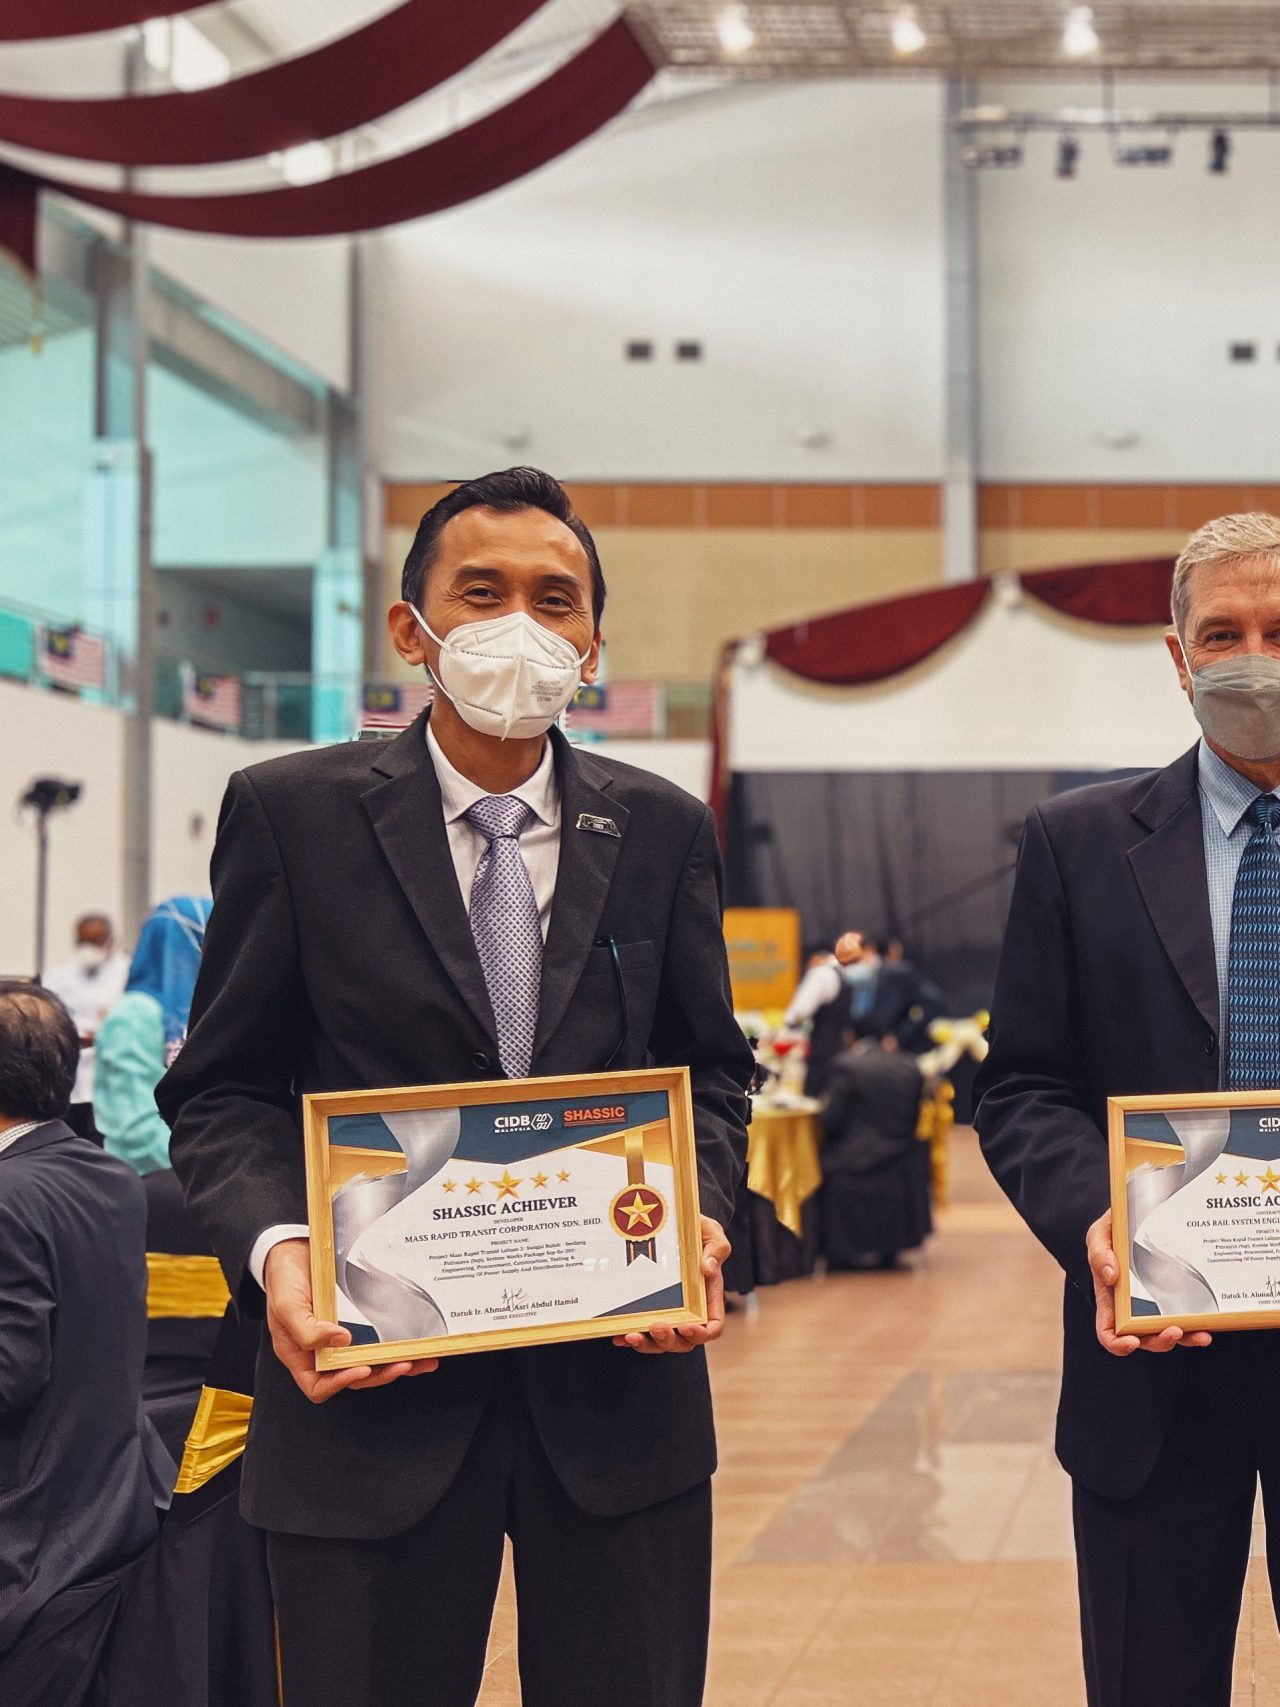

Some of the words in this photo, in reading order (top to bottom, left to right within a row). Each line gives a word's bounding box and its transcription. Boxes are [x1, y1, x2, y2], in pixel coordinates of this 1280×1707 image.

[494, 1115, 530, 1128] CIDB
[564, 1106, 625, 1122] SHASSIC
[432, 1203, 497, 1221] SHASSIC
[501, 1196, 578, 1215] ACHIEVER
[1206, 1196, 1261, 1209] SHASSIC
[404, 1234, 429, 1243] MASS
[430, 1231, 458, 1241] RAPID
[459, 1227, 497, 1238] TRANSIT
[498, 1221, 560, 1234] CORPORATION
[562, 1219, 581, 1228] SDN.
[583, 1217, 604, 1226] BHD.
[1186, 1220, 1211, 1228] COLAS
[1231, 1217, 1261, 1225] SYSTEM
[450, 1309, 473, 1318] Datuk
[484, 1305, 511, 1314] Ahmad
[514, 1303, 529, 1311] Asri
[530, 1300, 553, 1309] Abdul
[554, 1297, 579, 1307] Hamid
